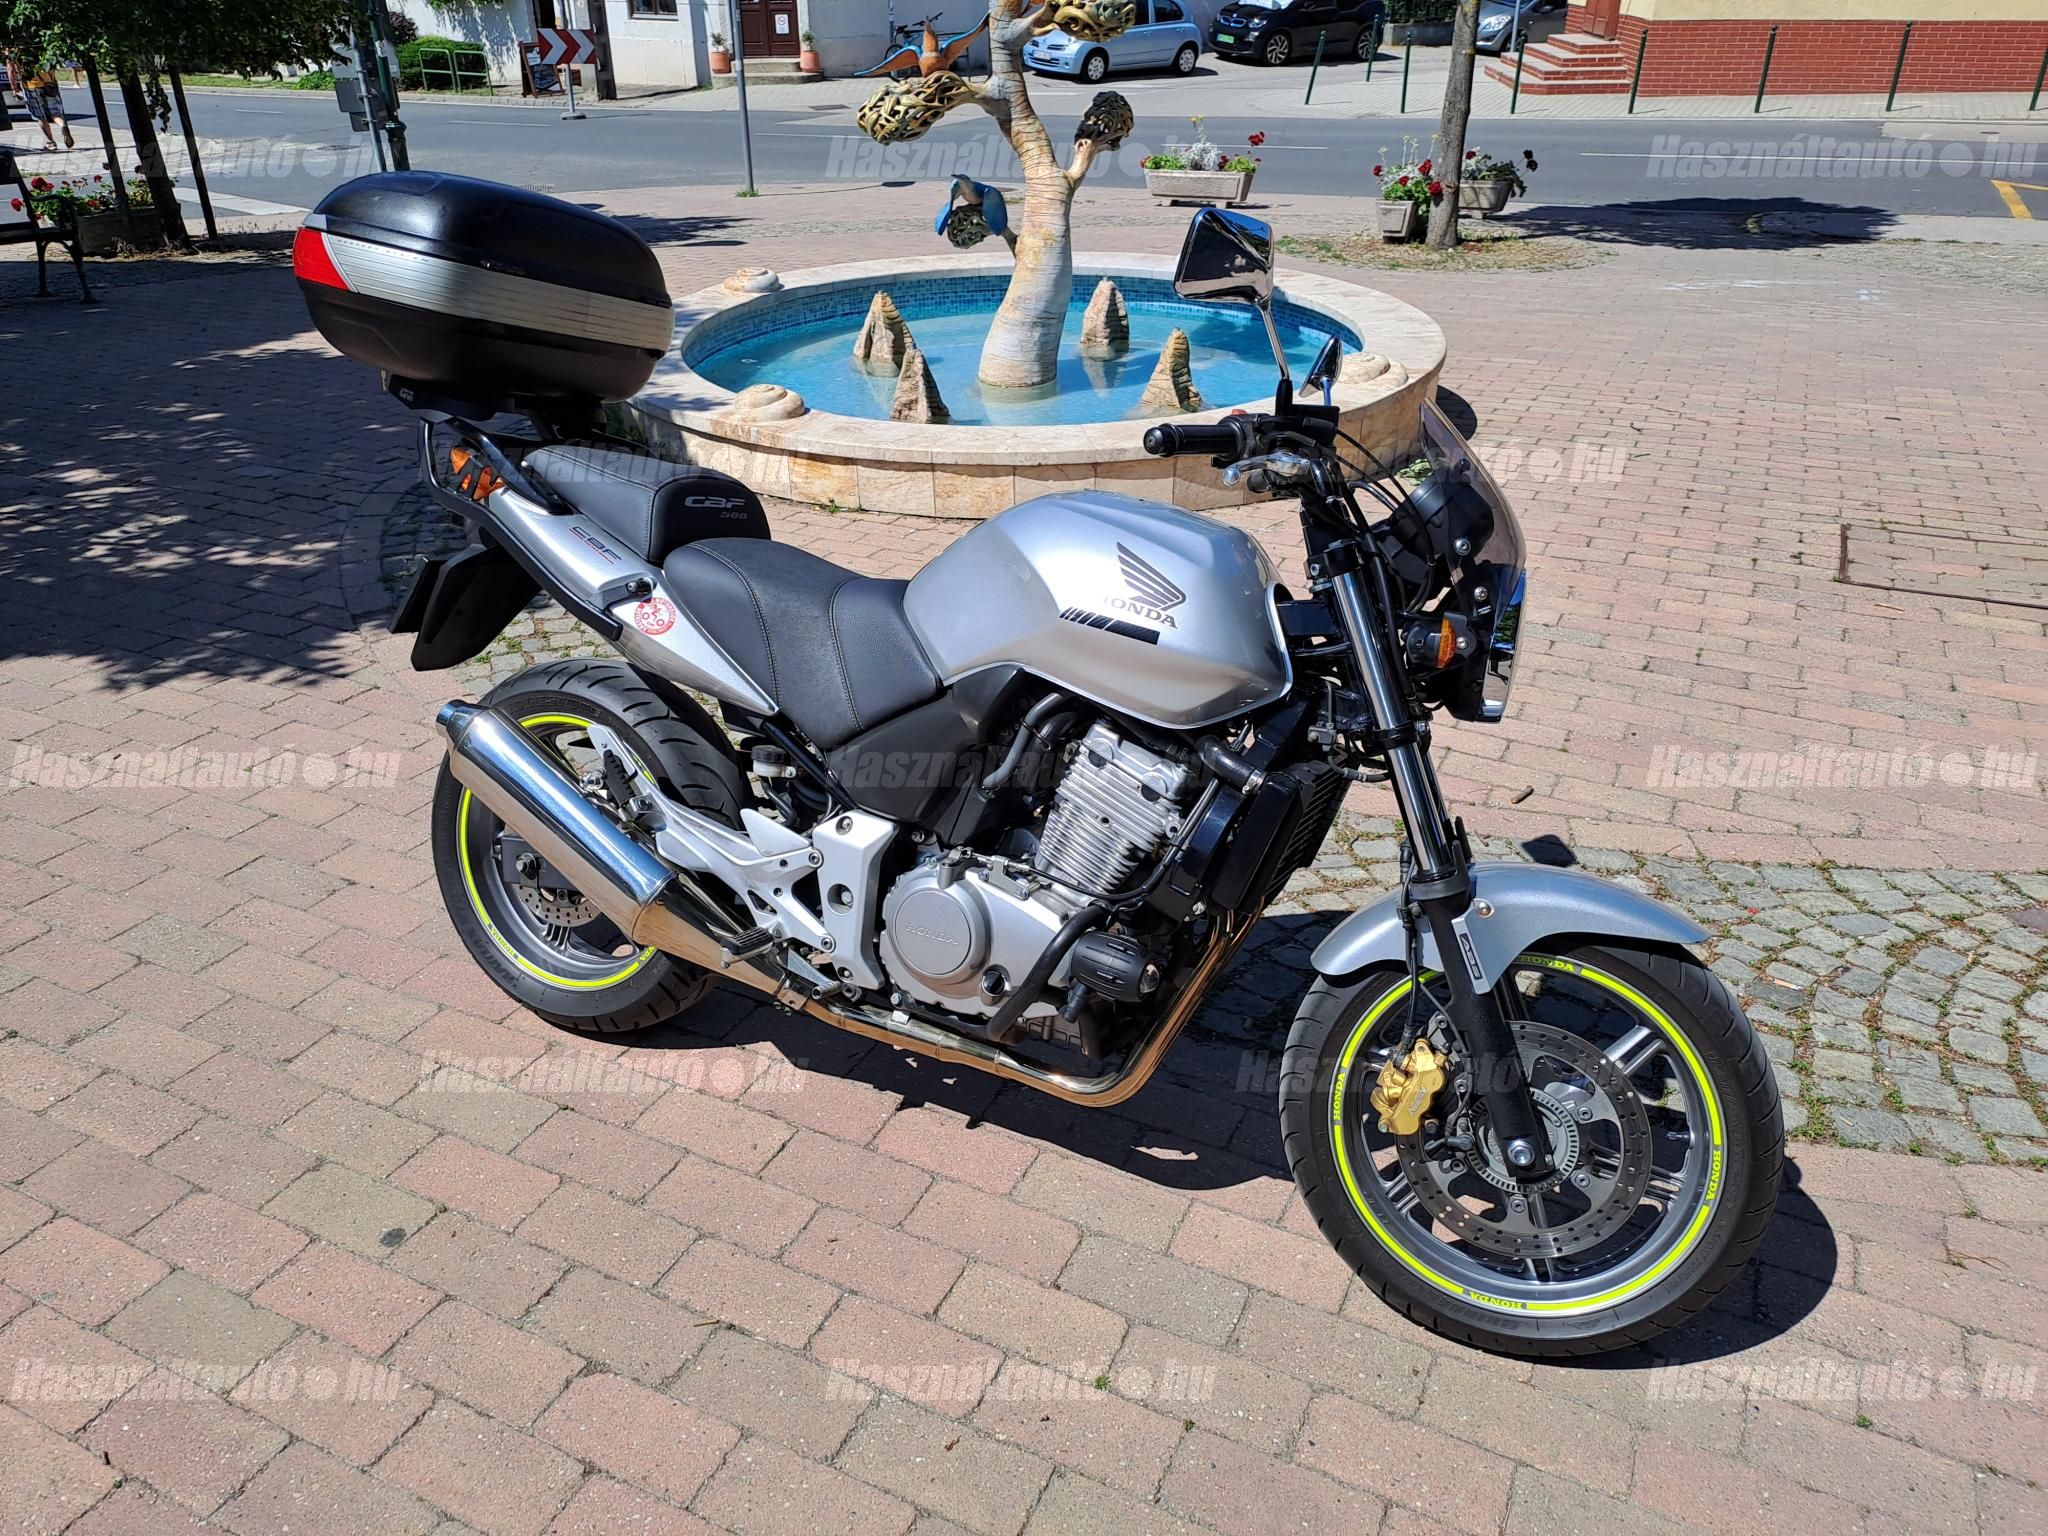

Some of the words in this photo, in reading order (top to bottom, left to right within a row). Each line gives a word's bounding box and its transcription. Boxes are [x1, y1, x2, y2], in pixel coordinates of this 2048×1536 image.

[684, 496, 746, 508] CBF
[571, 526, 622, 561] CBF
[1517, 954, 1576, 973] HONDA
[1333, 1071, 1347, 1121] HONDA
[1705, 1149, 1721, 1202] HONDA
[1467, 1290, 1523, 1311] HONDA
